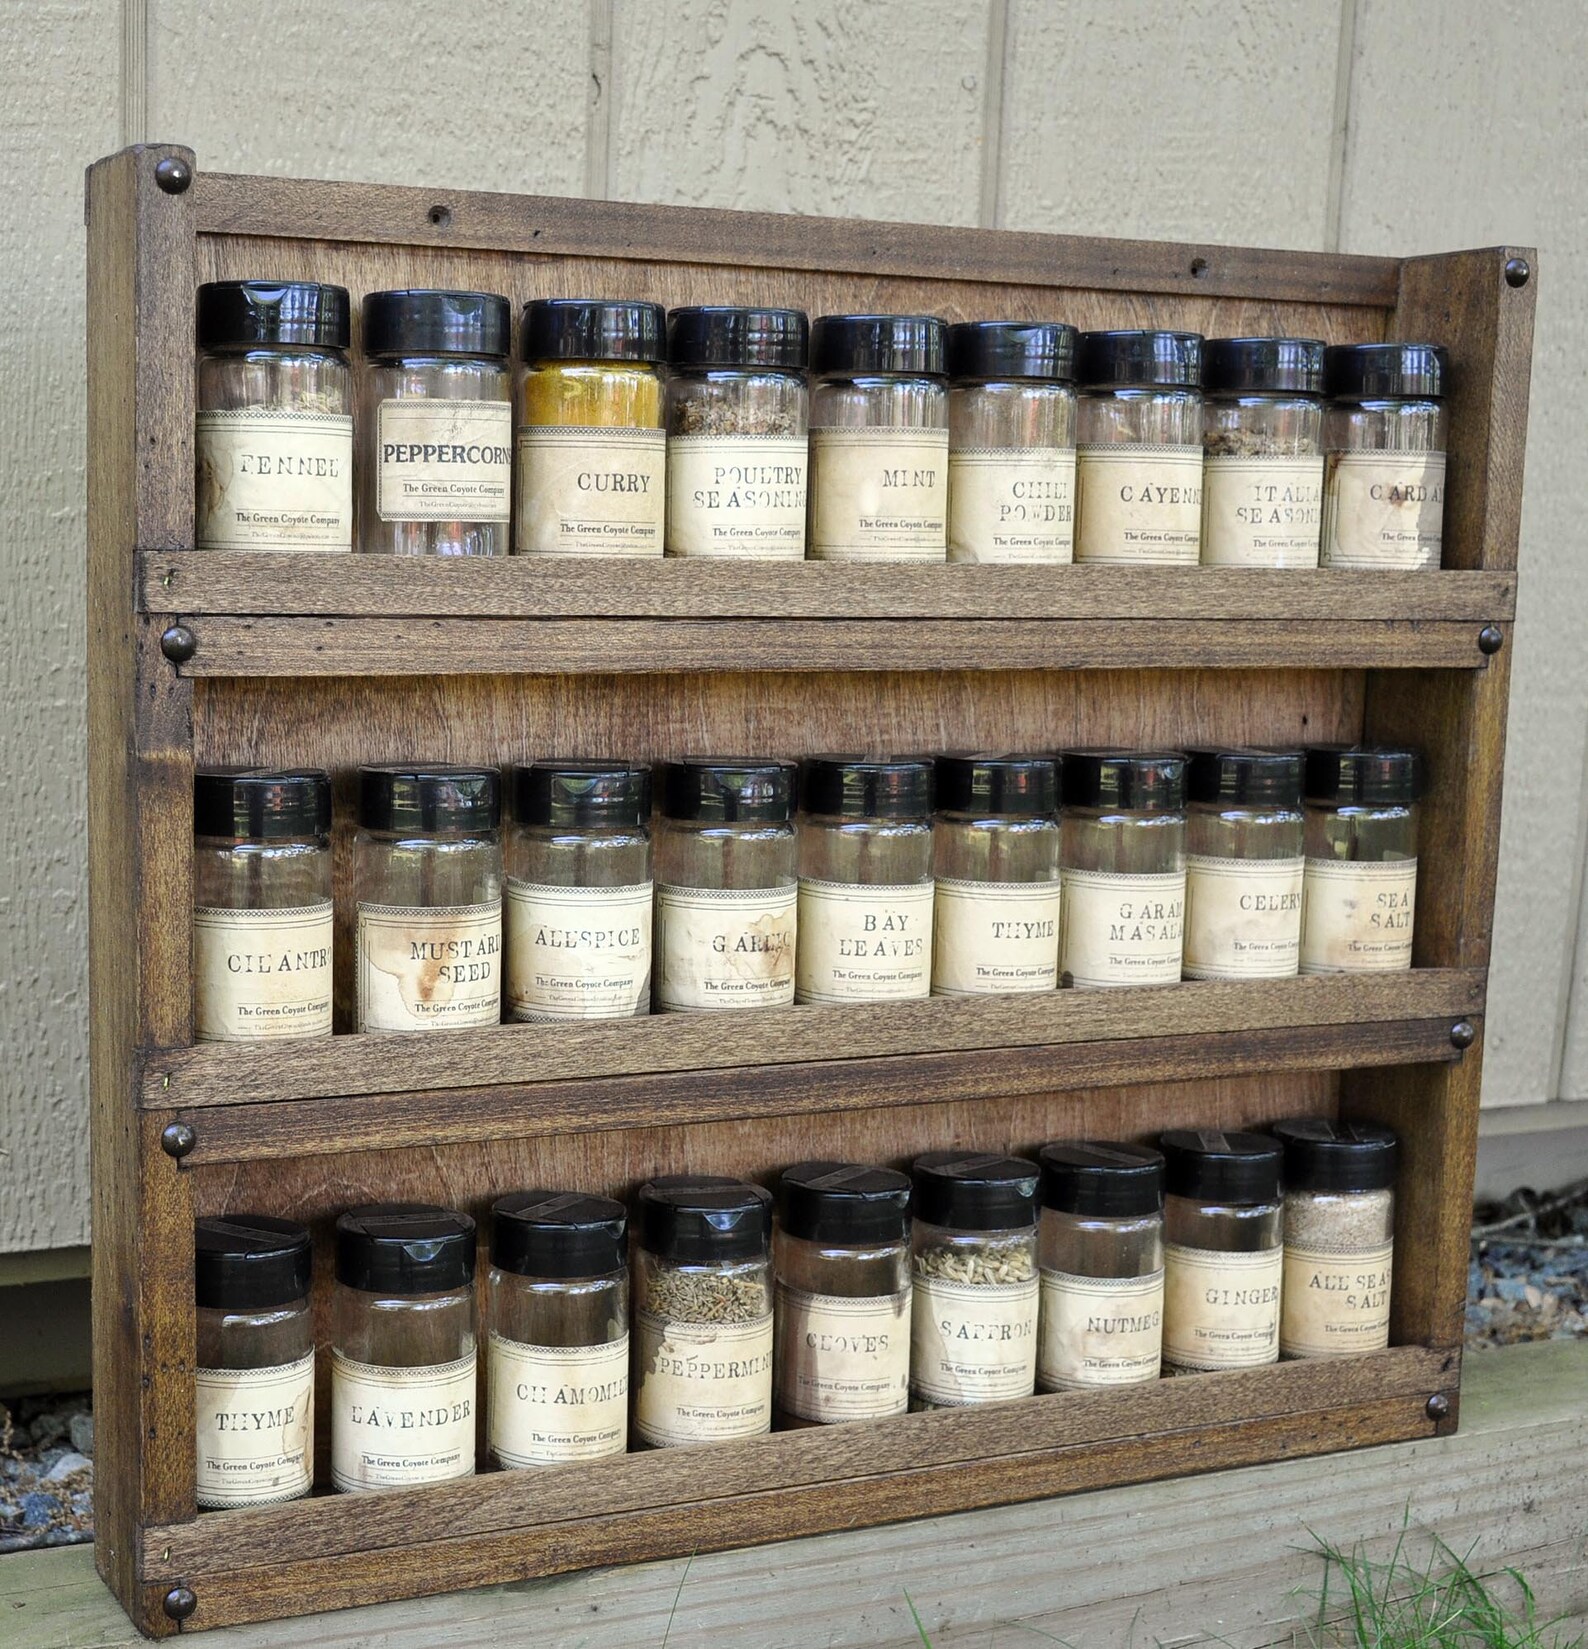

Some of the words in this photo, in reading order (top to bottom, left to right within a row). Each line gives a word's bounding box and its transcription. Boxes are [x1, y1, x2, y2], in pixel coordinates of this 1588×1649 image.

[241, 455, 338, 477] FENNEL
[577, 473, 650, 492] CURRY
[716, 467, 801, 485] POULTRY
[883, 470, 935, 487] MINT
[403, 484, 419, 493] The
[422, 484, 447, 494] Green
[450, 484, 477, 495] Coyote
[236, 513, 250, 523] The
[253, 513, 279, 524] Green
[281, 514, 309, 526] Coyote
[311, 516, 340, 527] Company
[859, 519, 873, 527] The
[876, 519, 898, 528] Green
[900, 520, 922, 530] Coyote
[560, 524, 575, 532] The
[577, 524, 601, 533] Green
[604, 525, 629, 535] Coyote
[714, 528, 727, 537] The
[730, 528, 753, 537] Green
[755, 528, 778, 539] Coyote
[1124, 532, 1138, 540] The
[993, 537, 1007, 545] The
[1034, 538, 1054, 548] Coyote
[1377, 892, 1408, 908] SEA
[864, 914, 908, 931] BAY
[1370, 912, 1410, 928] SALT
[992, 921, 1054, 938] THYME
[535, 928, 640, 948] ALLSPICE
[713, 932, 790, 952] GARLIC
[840, 939, 922, 956] LEAVES
[1234, 942, 1246, 950] The
[439, 963, 491, 984] SEED
[832, 970, 846, 978] The
[849, 971, 870, 979] Green
[873, 972, 896, 981] Coyote
[977, 967, 990, 976] The
[993, 968, 1014, 976] Green
[1015, 968, 1036, 978] Coyote
[536, 977, 548, 986] The
[551, 978, 573, 988] Green
[576, 978, 602, 989] Coyote
[604, 978, 633, 988] Company
[704, 981, 718, 990] The
[721, 981, 744, 990] Green
[746, 981, 768, 991] Coyote
[238, 1006, 253, 1016] The
[255, 1006, 280, 1016] Green
[282, 1004, 306, 1016] Coyote
[415, 1004, 429, 1012] The
[432, 1004, 456, 1013] Green
[458, 1001, 480, 1012] Coyote
[1310, 1275, 1349, 1290] ALL
[1206, 1286, 1277, 1305] GINGER
[1345, 1291, 1386, 1309] SALT
[940, 1320, 1032, 1340] SAFFRON
[1087, 1311, 1158, 1334] NUTMEG
[806, 1333, 888, 1353] CLOVES
[941, 1363, 952, 1372] The
[955, 1365, 976, 1374] Green
[978, 1366, 1001, 1376] Coyote
[798, 1377, 810, 1386] The
[812, 1379, 833, 1390] Green
[835, 1381, 859, 1392] Coyote
[861, 1382, 890, 1392] Company
[216, 1406, 294, 1431] THYME
[352, 1400, 470, 1428] LAVENDER
[677, 1407, 690, 1416] The
[692, 1409, 715, 1418] Green
[717, 1408, 740, 1419] Coyote
[532, 1433, 545, 1442] The
[548, 1435, 571, 1443] Green
[573, 1432, 597, 1444] Coyote
[207, 1460, 220, 1471] The
[223, 1461, 248, 1471] Green
[250, 1459, 276, 1470] Coyote
[362, 1456, 375, 1465] The
[377, 1458, 400, 1467] Green
[402, 1457, 429, 1469] Coyote
[431, 1453, 460, 1466] Company
